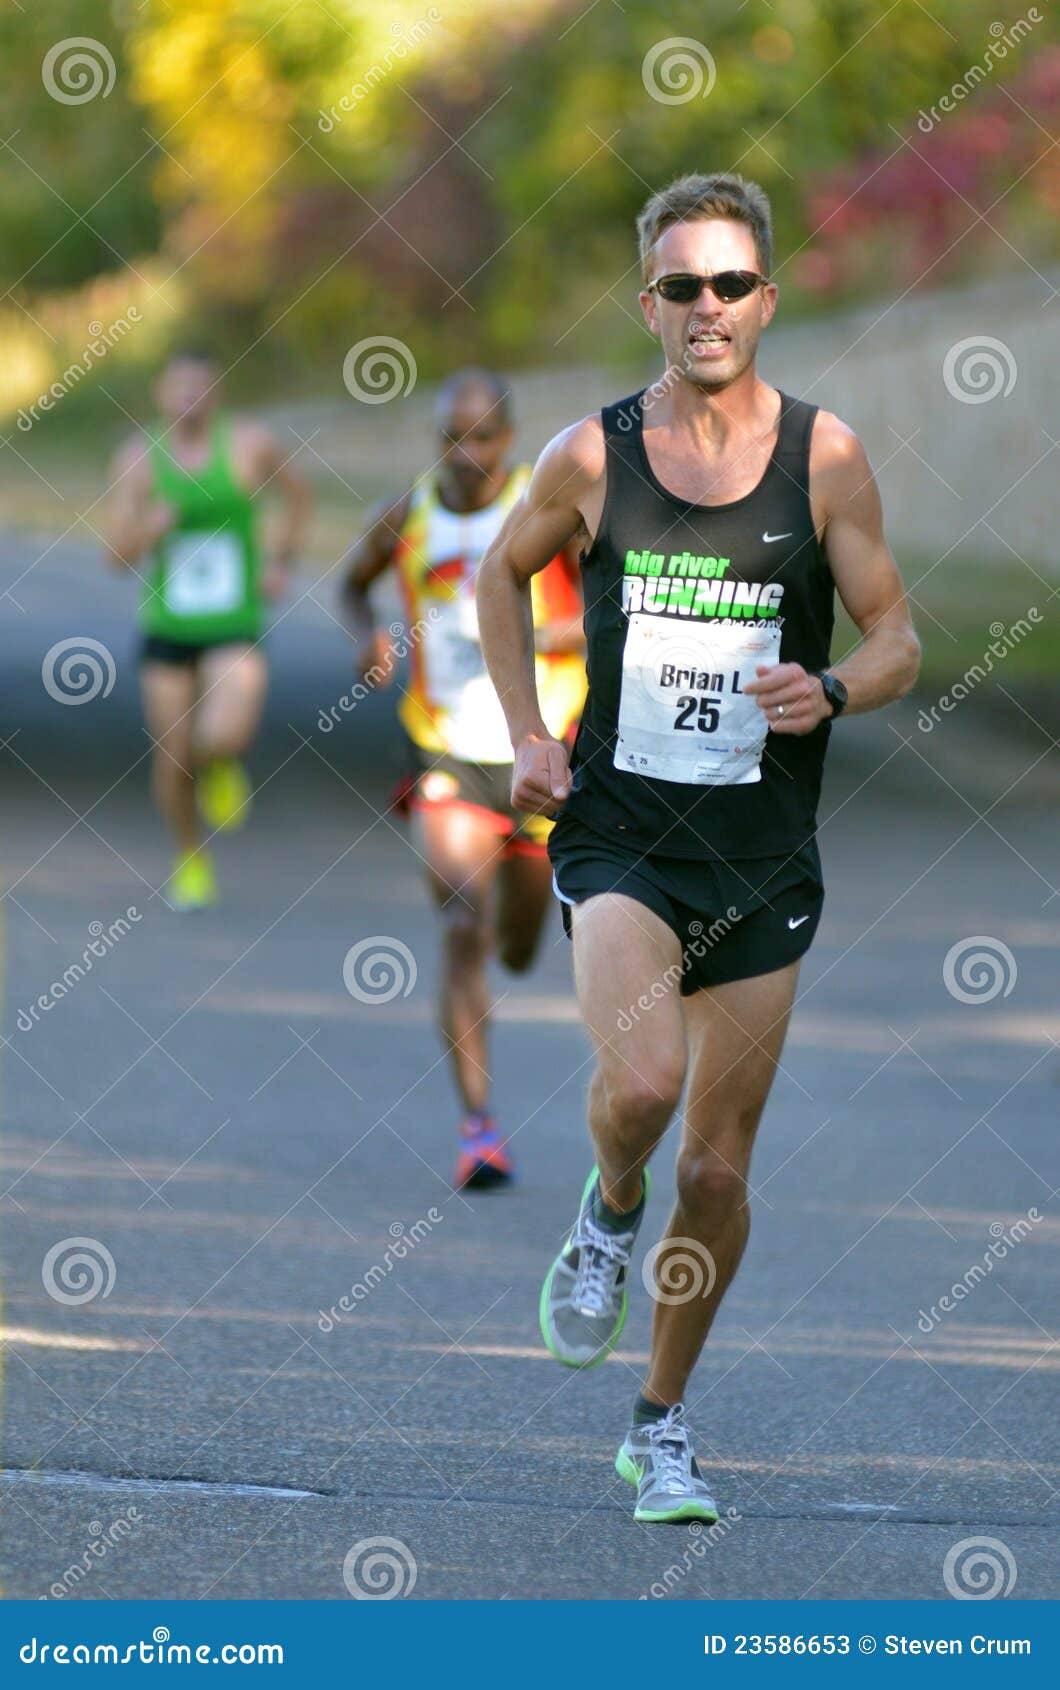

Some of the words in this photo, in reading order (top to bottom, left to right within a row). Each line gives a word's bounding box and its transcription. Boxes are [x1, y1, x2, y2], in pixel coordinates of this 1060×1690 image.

[624, 550, 665, 577] big
[667, 552, 730, 578] river
[622, 576, 784, 618] RUNNING
[660, 663, 724, 693] Brian
[731, 670, 743, 694] L
[673, 695, 722, 734] 25
